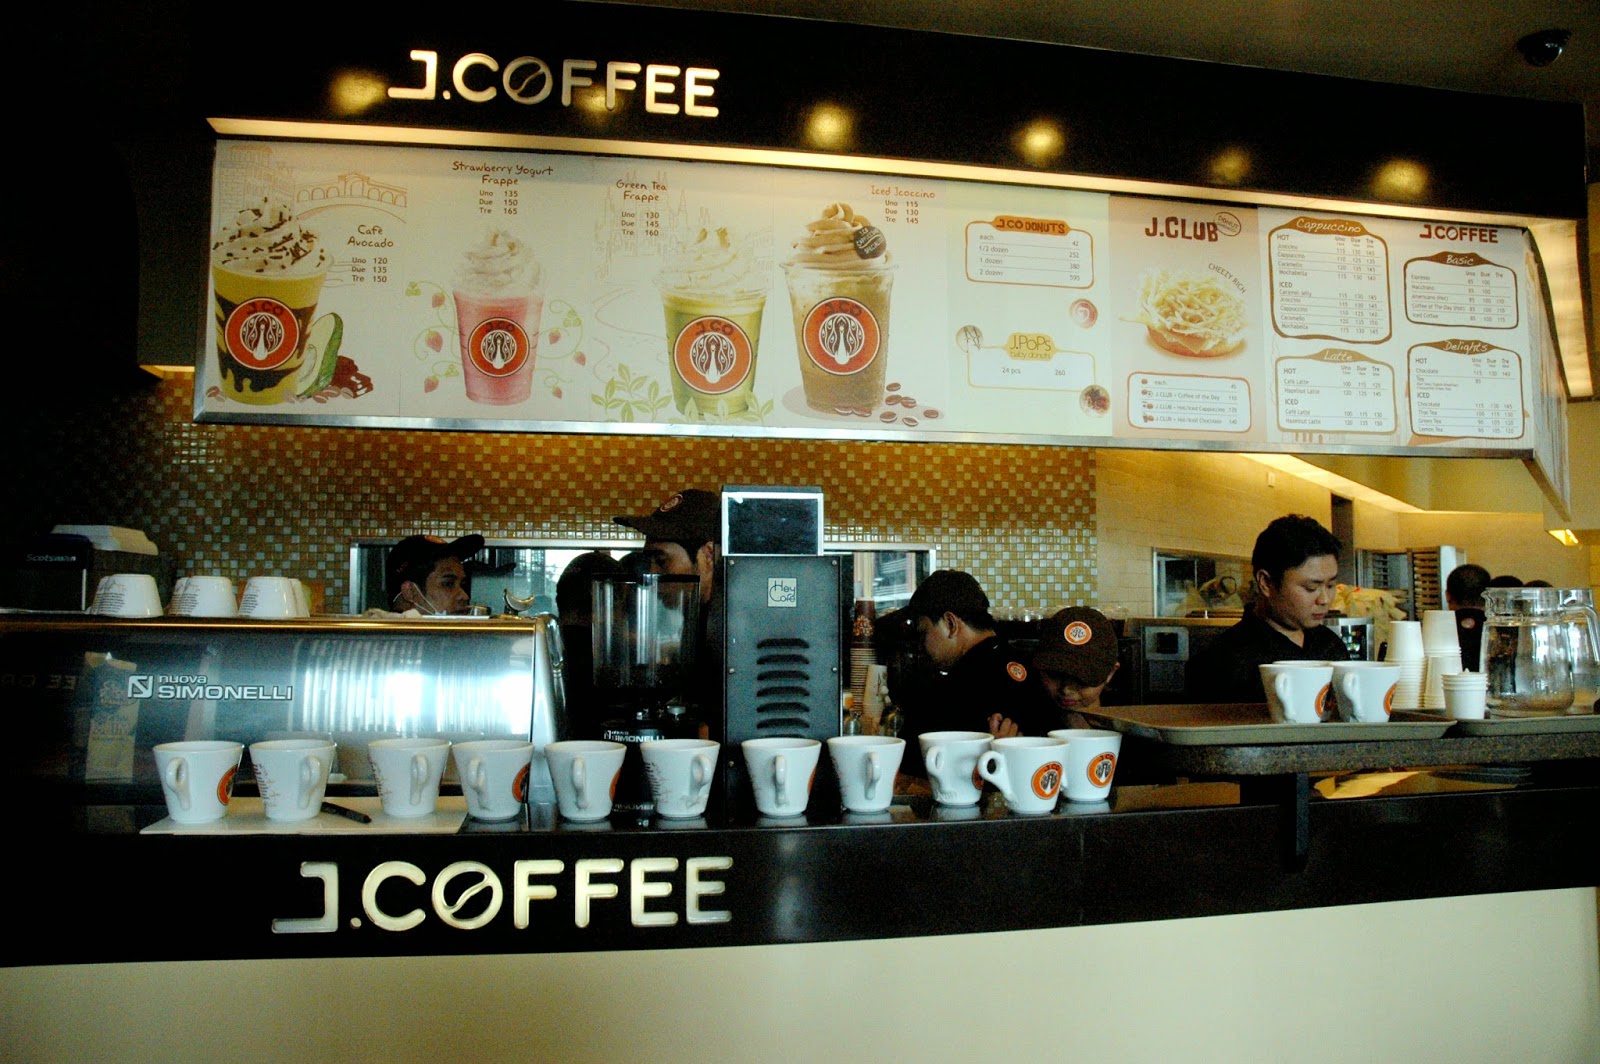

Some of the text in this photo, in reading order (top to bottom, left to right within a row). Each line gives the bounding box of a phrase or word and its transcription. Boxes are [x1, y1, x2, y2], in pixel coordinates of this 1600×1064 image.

[387, 50, 720, 118] J.COFFEE
[452, 161, 553, 178] Strawberry Yogurt
[482, 175, 518, 186] Frappe
[616, 179, 667, 190] Green Tea
[871, 186, 890, 195] Iced
[624, 191, 659, 203] Frappe
[1026, 222, 1065, 234] DONUTS
[1145, 216, 1218, 242] J.CLUB
[1296, 219, 1361, 232] Cappuccino
[347, 236, 393, 247] Avocado
[1447, 255, 1473, 265] Basic
[1208, 263, 1246, 293] CHEEZY RICH
[1443, 340, 1487, 355] Delights
[1324, 351, 1352, 361] Latte
[774, 580, 795, 596] Hey
[159, 675, 207, 683] nuova
[158, 686, 293, 700] SIMONELLI
[272, 856, 733, 933] J.COFFEE
